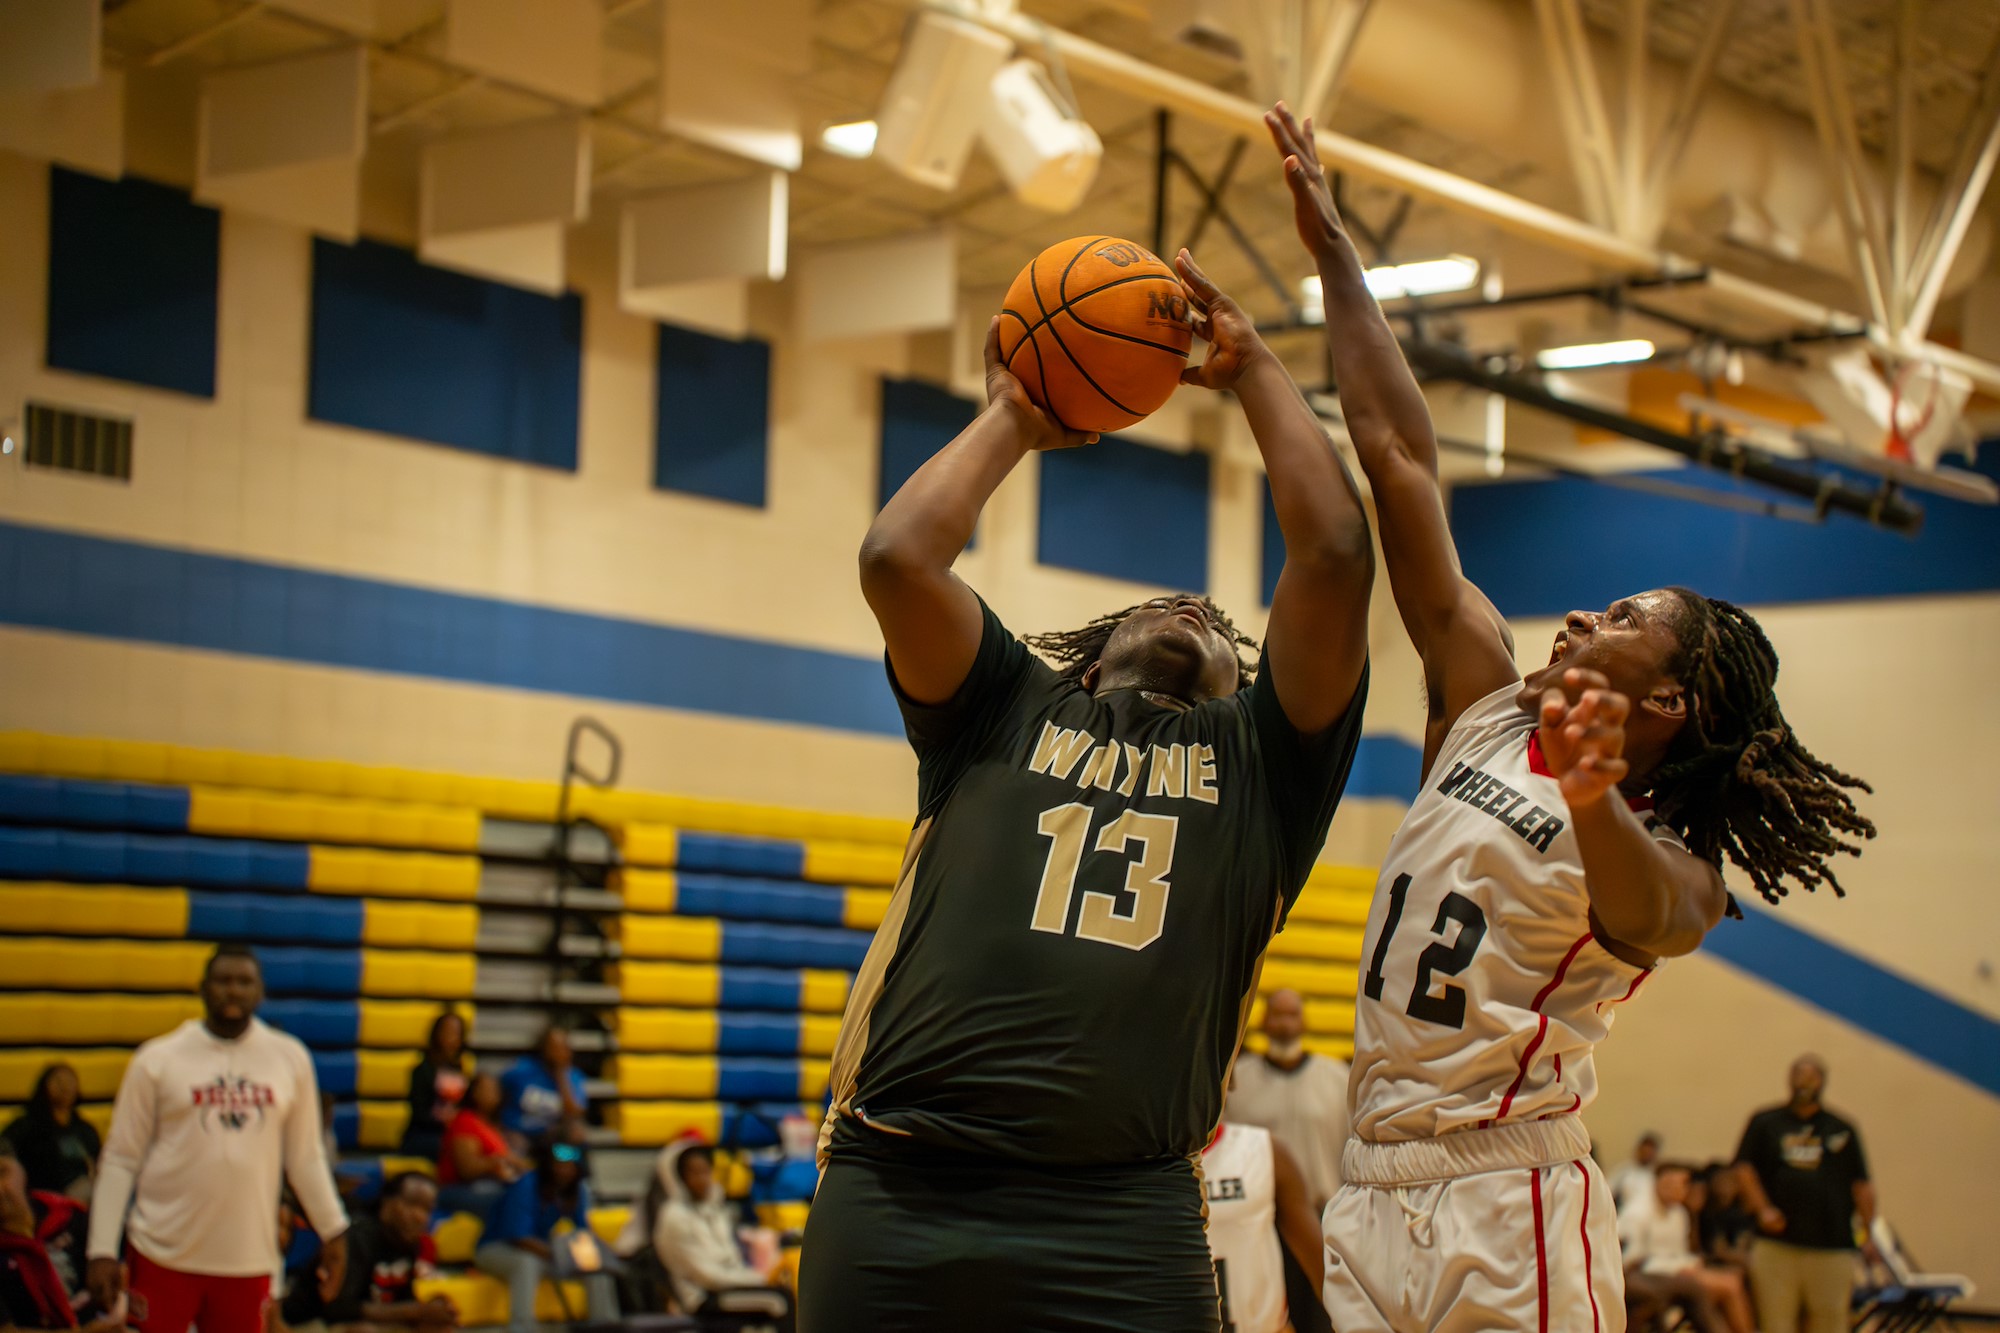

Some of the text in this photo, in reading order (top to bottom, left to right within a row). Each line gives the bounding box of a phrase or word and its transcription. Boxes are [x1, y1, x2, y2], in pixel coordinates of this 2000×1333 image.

[1028, 720, 1219, 804] WAYNE
[1437, 761, 1564, 853] WHEELER
[1030, 802, 1179, 951] 13
[1365, 872, 1487, 1029] 12
